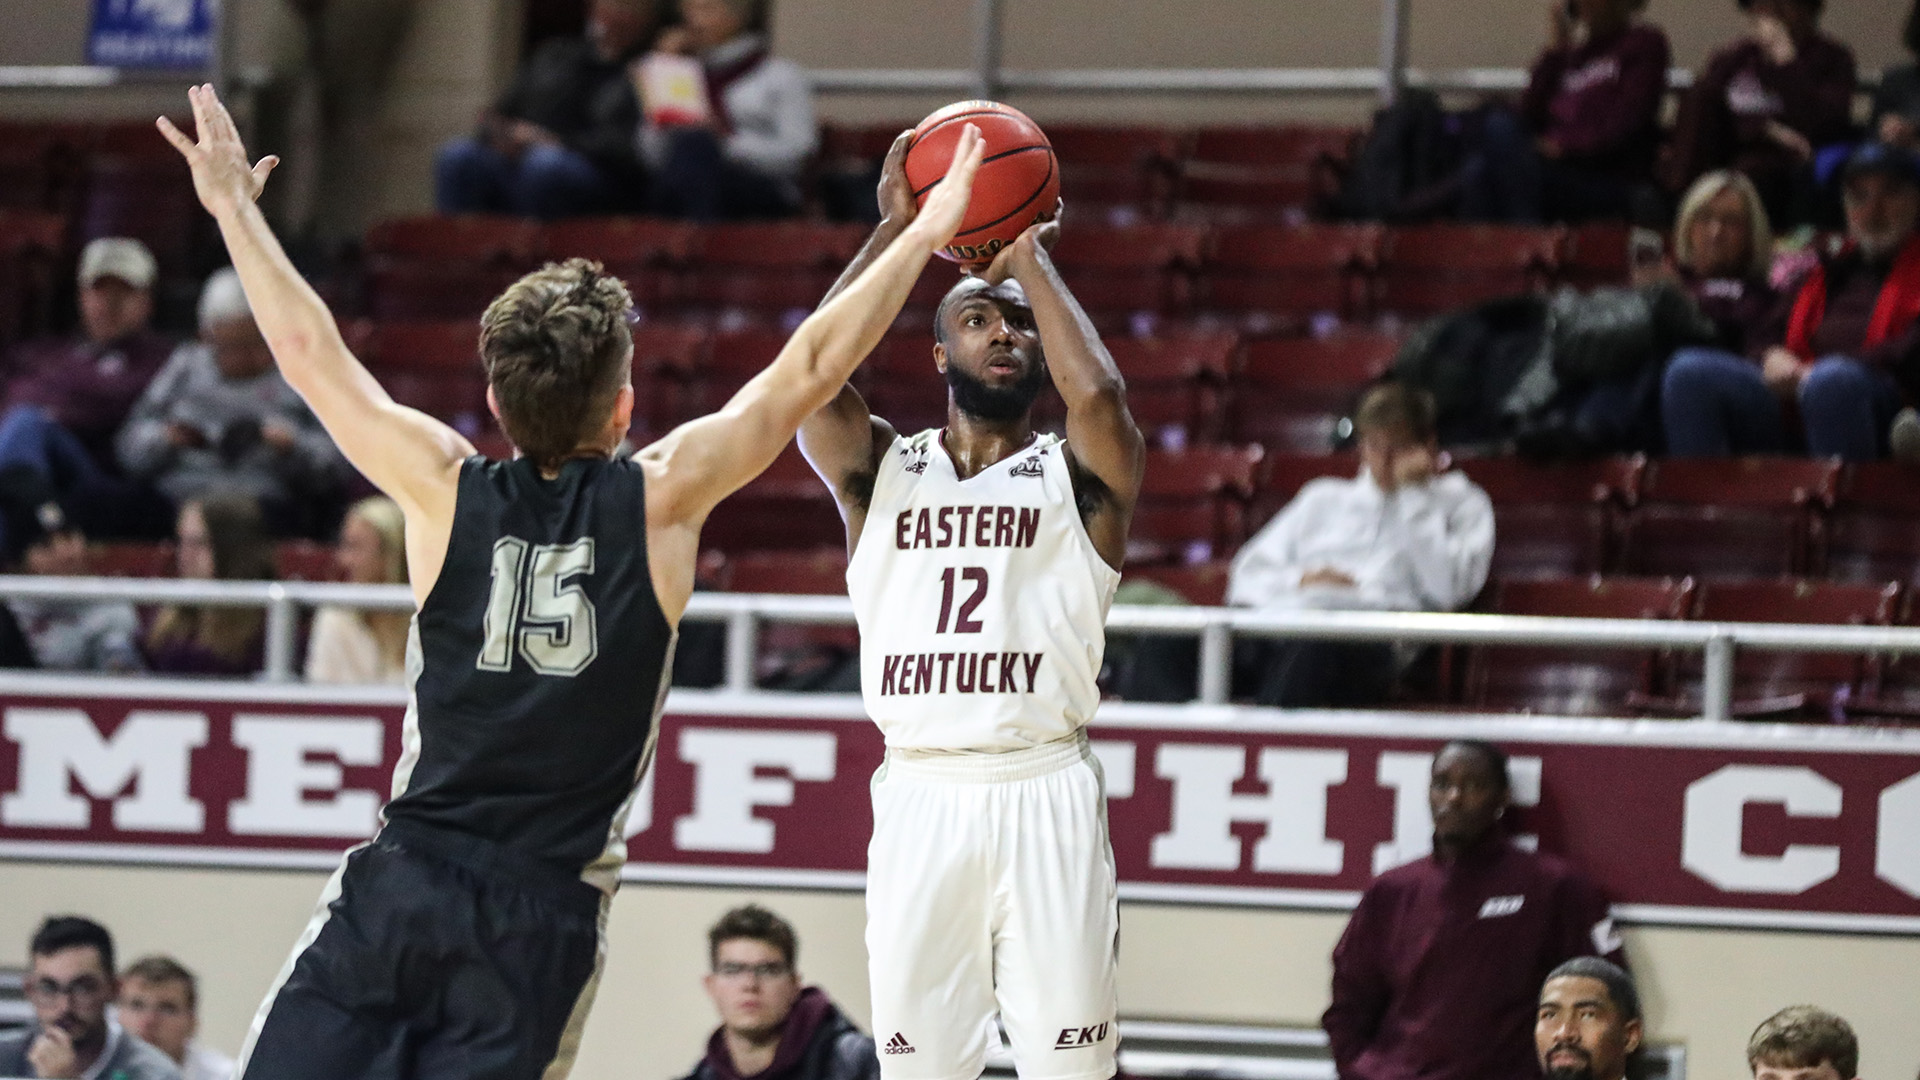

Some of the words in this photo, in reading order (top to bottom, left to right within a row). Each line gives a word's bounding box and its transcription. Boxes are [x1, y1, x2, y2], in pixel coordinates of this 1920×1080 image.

[896, 505, 1041, 550] EASTERN
[476, 535, 598, 677] 15
[936, 566, 989, 634] 12
[881, 652, 1044, 696] KENTUCKY
[1, 707, 385, 837] ME
[624, 727, 838, 854] F
[1681, 764, 1920, 899] C
[884, 1045, 916, 1055] adidas
[1056, 1021, 1109, 1046] EKU
